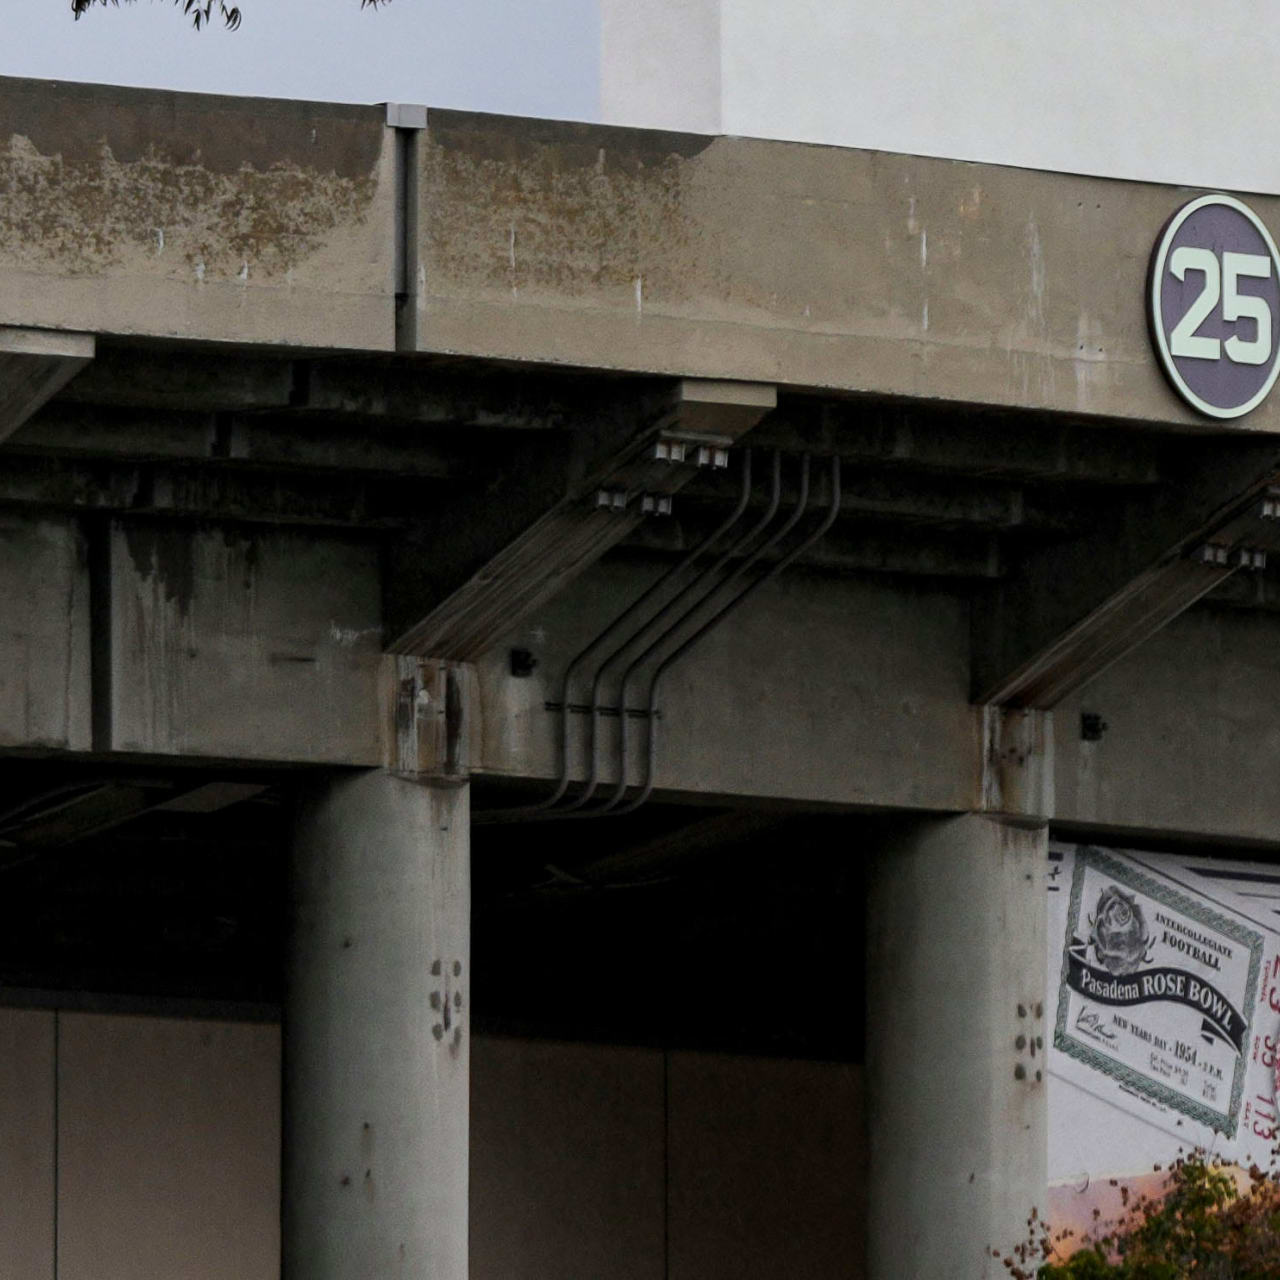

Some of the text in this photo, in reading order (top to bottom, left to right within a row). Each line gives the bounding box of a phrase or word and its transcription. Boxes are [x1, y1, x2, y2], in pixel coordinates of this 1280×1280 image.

[1170, 246, 1272, 366] 25
[1155, 911, 1233, 960] INTERCOLLEGIATE
[1162, 930, 1221, 972] FOOTBALL
[1081, 968, 1233, 1031] Pasadena ROSE BOWL
